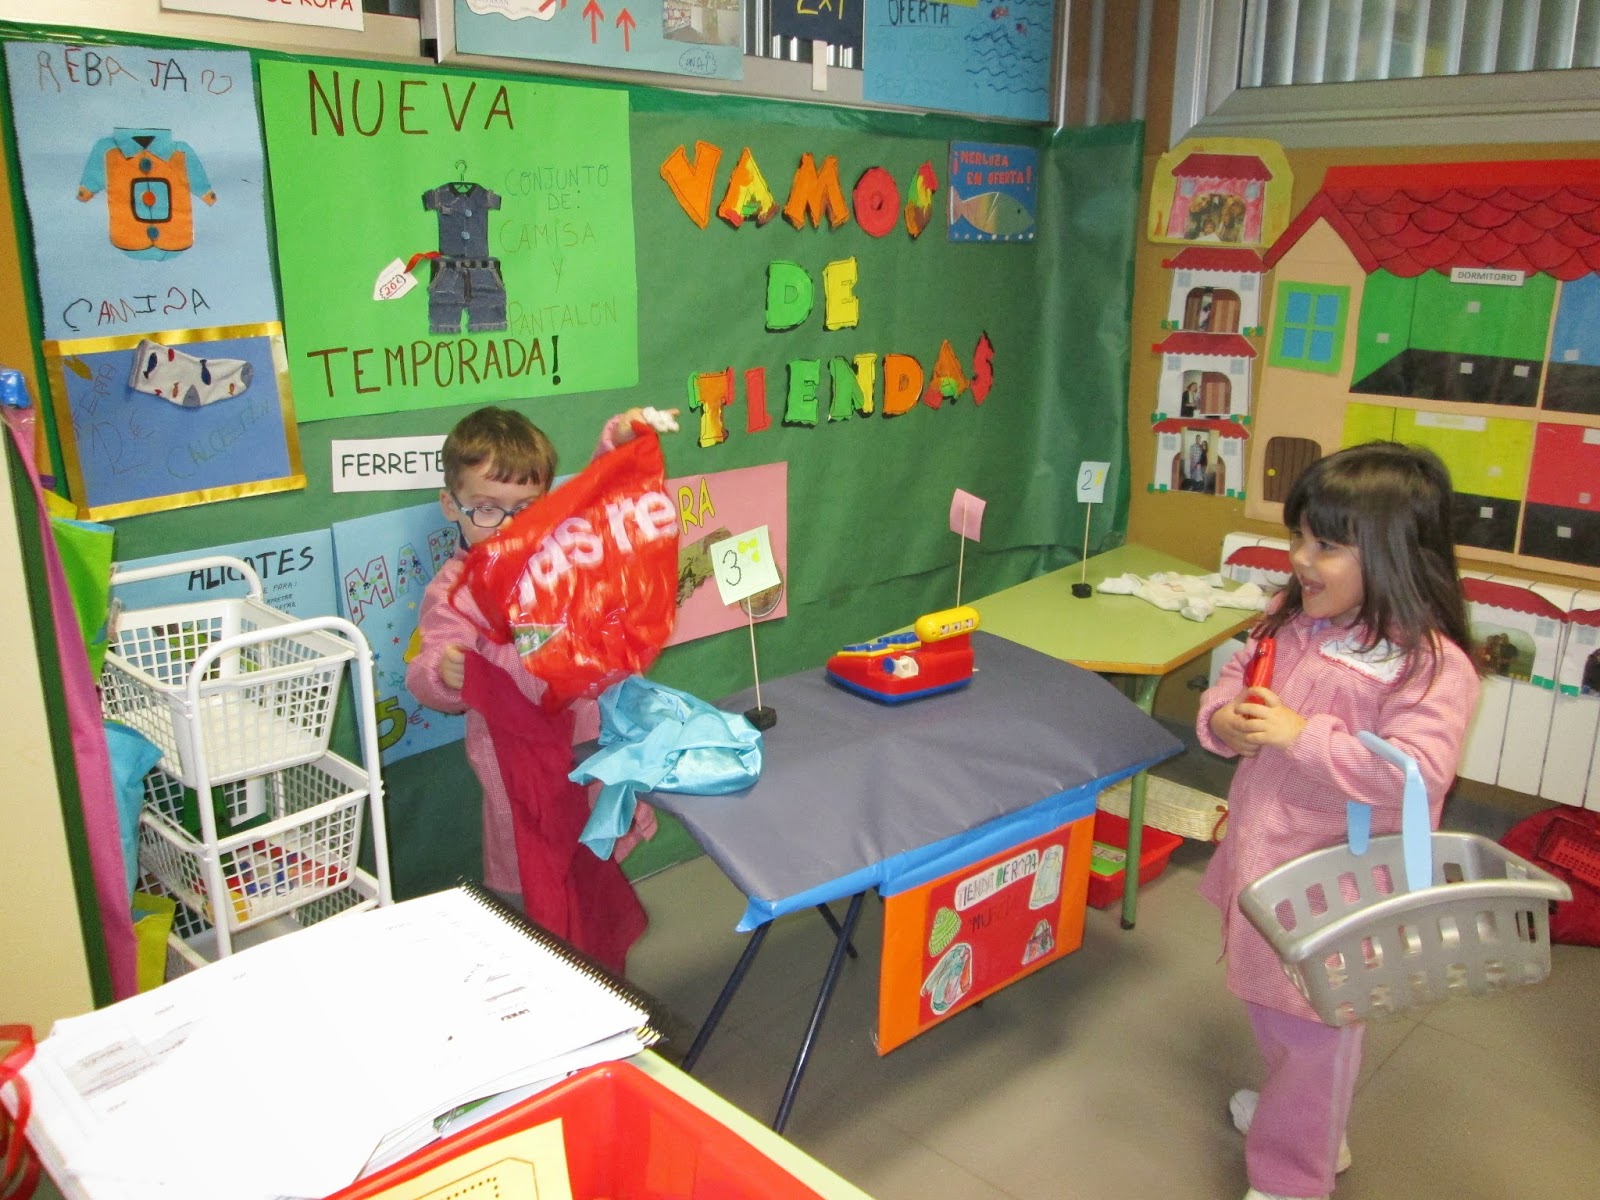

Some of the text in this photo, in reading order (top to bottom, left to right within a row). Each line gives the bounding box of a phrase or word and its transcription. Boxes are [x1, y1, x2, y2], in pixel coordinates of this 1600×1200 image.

[888, 0, 949, 25] OFERTA
[308, 69, 514, 137] NUEVA
[505, 164, 609, 196] CONJUNTO
[660, 140, 939, 238] VAMOS
[966, 172, 982, 185] EN
[765, 256, 860, 333] DE
[1458, 272, 1516, 281] DORMITORIO
[307, 335, 561, 397] TEMPORADA!
[687, 331, 994, 448] TIENDAS
[341, 449, 445, 478] FERRETE
[1081, 469, 1093, 491] 2
[678, 477, 715, 535] RA
[722, 550, 741, 586] 3
[957, 872, 995, 908] TIENDA
